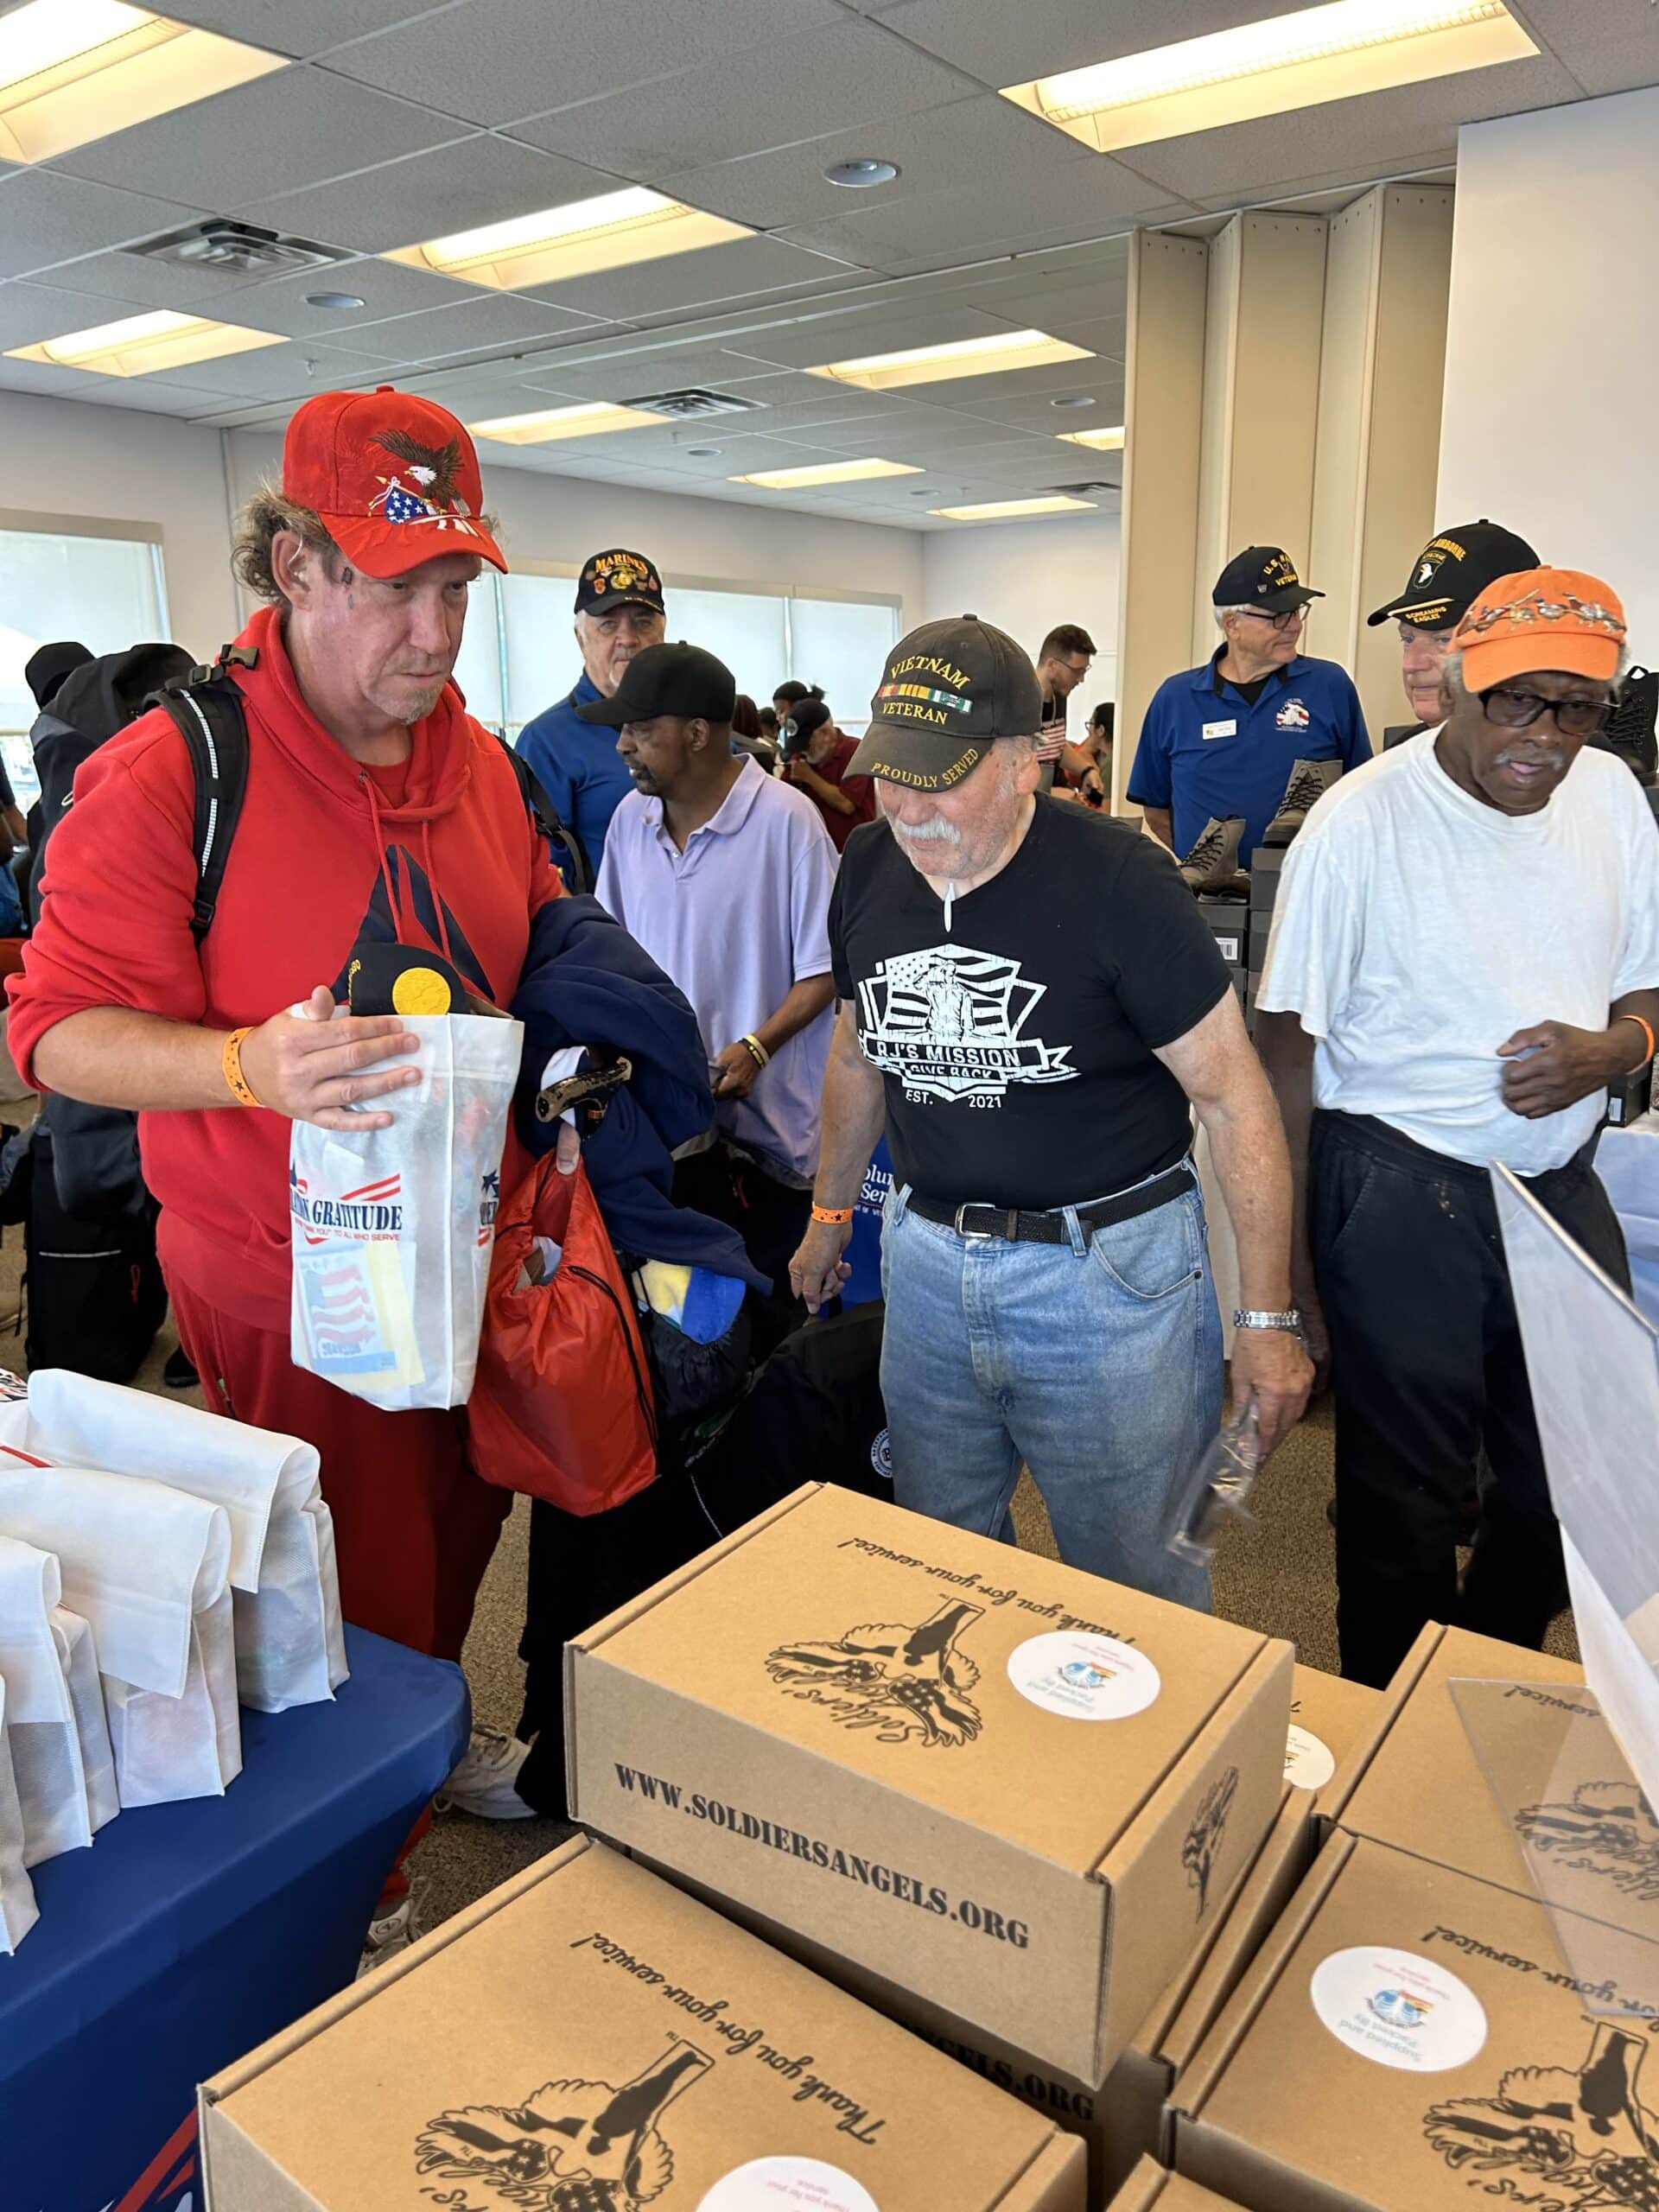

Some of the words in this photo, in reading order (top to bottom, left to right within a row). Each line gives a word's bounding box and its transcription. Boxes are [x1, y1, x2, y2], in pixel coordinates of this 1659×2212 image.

[594, 553, 649, 575] MARINES
[891, 656, 970, 690] VIETNAM
[881, 702, 948, 725] VETERAN
[870, 762, 938, 788] PROUDLY
[942, 747, 979, 785] SERVED
[876, 1040, 919, 1059] RJ'S
[925, 1046, 1022, 1068] MISSION
[906, 1090, 933, 1105] EST.
[968, 1096, 1002, 1109] 2021
[313, 1199, 403, 1230] GRATITUDE
[836, 1537, 925, 1569] service!
[924, 1567, 982, 1592] your
[976, 1585, 1017, 1605] for
[1015, 1598, 1065, 1621] you
[1502, 1686, 1600, 1718] service!
[614, 1762, 1029, 1949] WWW.SOLDIERSANGELS.ORG
[569, 1933, 664, 1989] service!
[1421, 1926, 1539, 1975] service!
[1541, 1969, 1618, 2004] your
[663, 1984, 728, 2026] your
[715, 2020, 764, 2056] for
[758, 2044, 814, 2083] you
[792, 2075, 886, 2145] Thank
